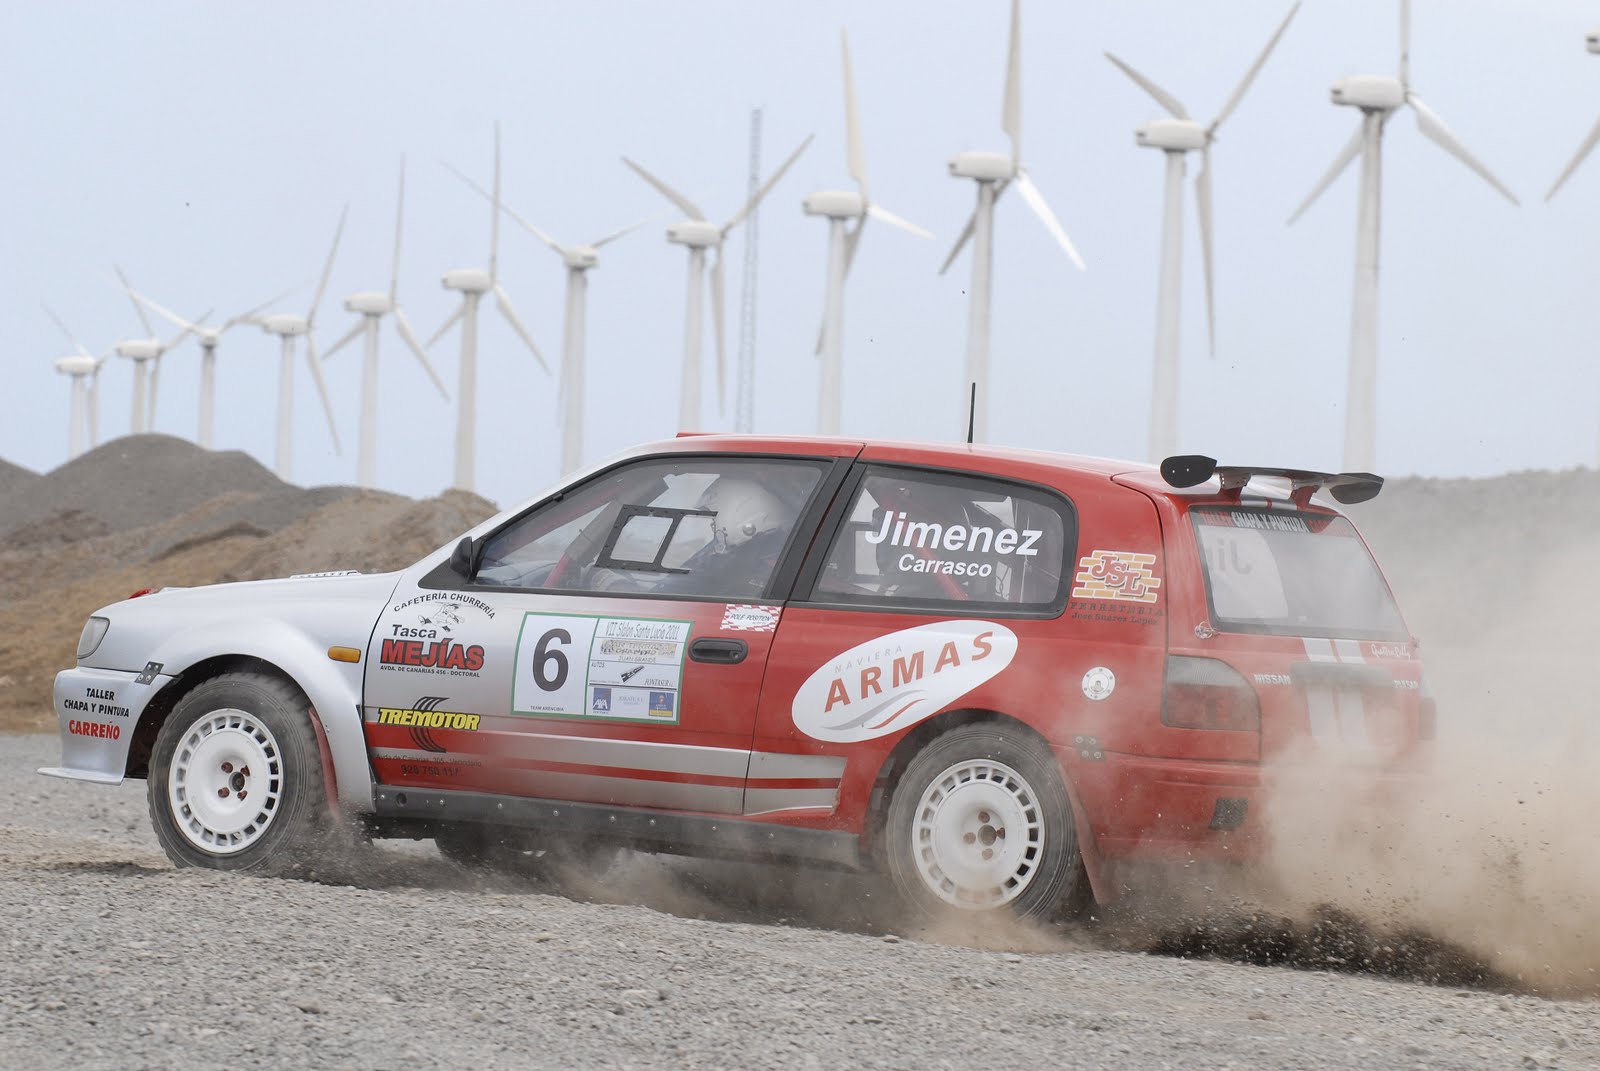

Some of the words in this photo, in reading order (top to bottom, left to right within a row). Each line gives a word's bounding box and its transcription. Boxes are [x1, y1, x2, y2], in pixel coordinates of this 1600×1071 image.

[864, 510, 1043, 556] Jimenez
[1231, 511, 1264, 529] CHAPA
[1260, 514, 1271, 529] Y
[1268, 514, 1311, 533] PINTURA
[899, 553, 992, 577] Carrasco
[1091, 554, 1146, 597] JSL
[450, 592, 495, 619] CHURRERÍA
[392, 624, 437, 639] Tasca
[380, 638, 485, 671] MEJÍAS
[532, 628, 572, 691] 6
[833, 645, 903, 673] NAVIERA
[824, 631, 993, 713] ARMAS
[1254, 673, 1291, 685] NISSAN
[86, 688, 115, 700] TALLER
[592, 698, 608, 709] AXA
[64, 699, 89, 712] CHAPA
[91, 703, 97, 712] Y
[98, 704, 129, 717] PINTURA
[378, 708, 481, 731] TREMOTOR
[69, 720, 120, 740] CARREÑO
